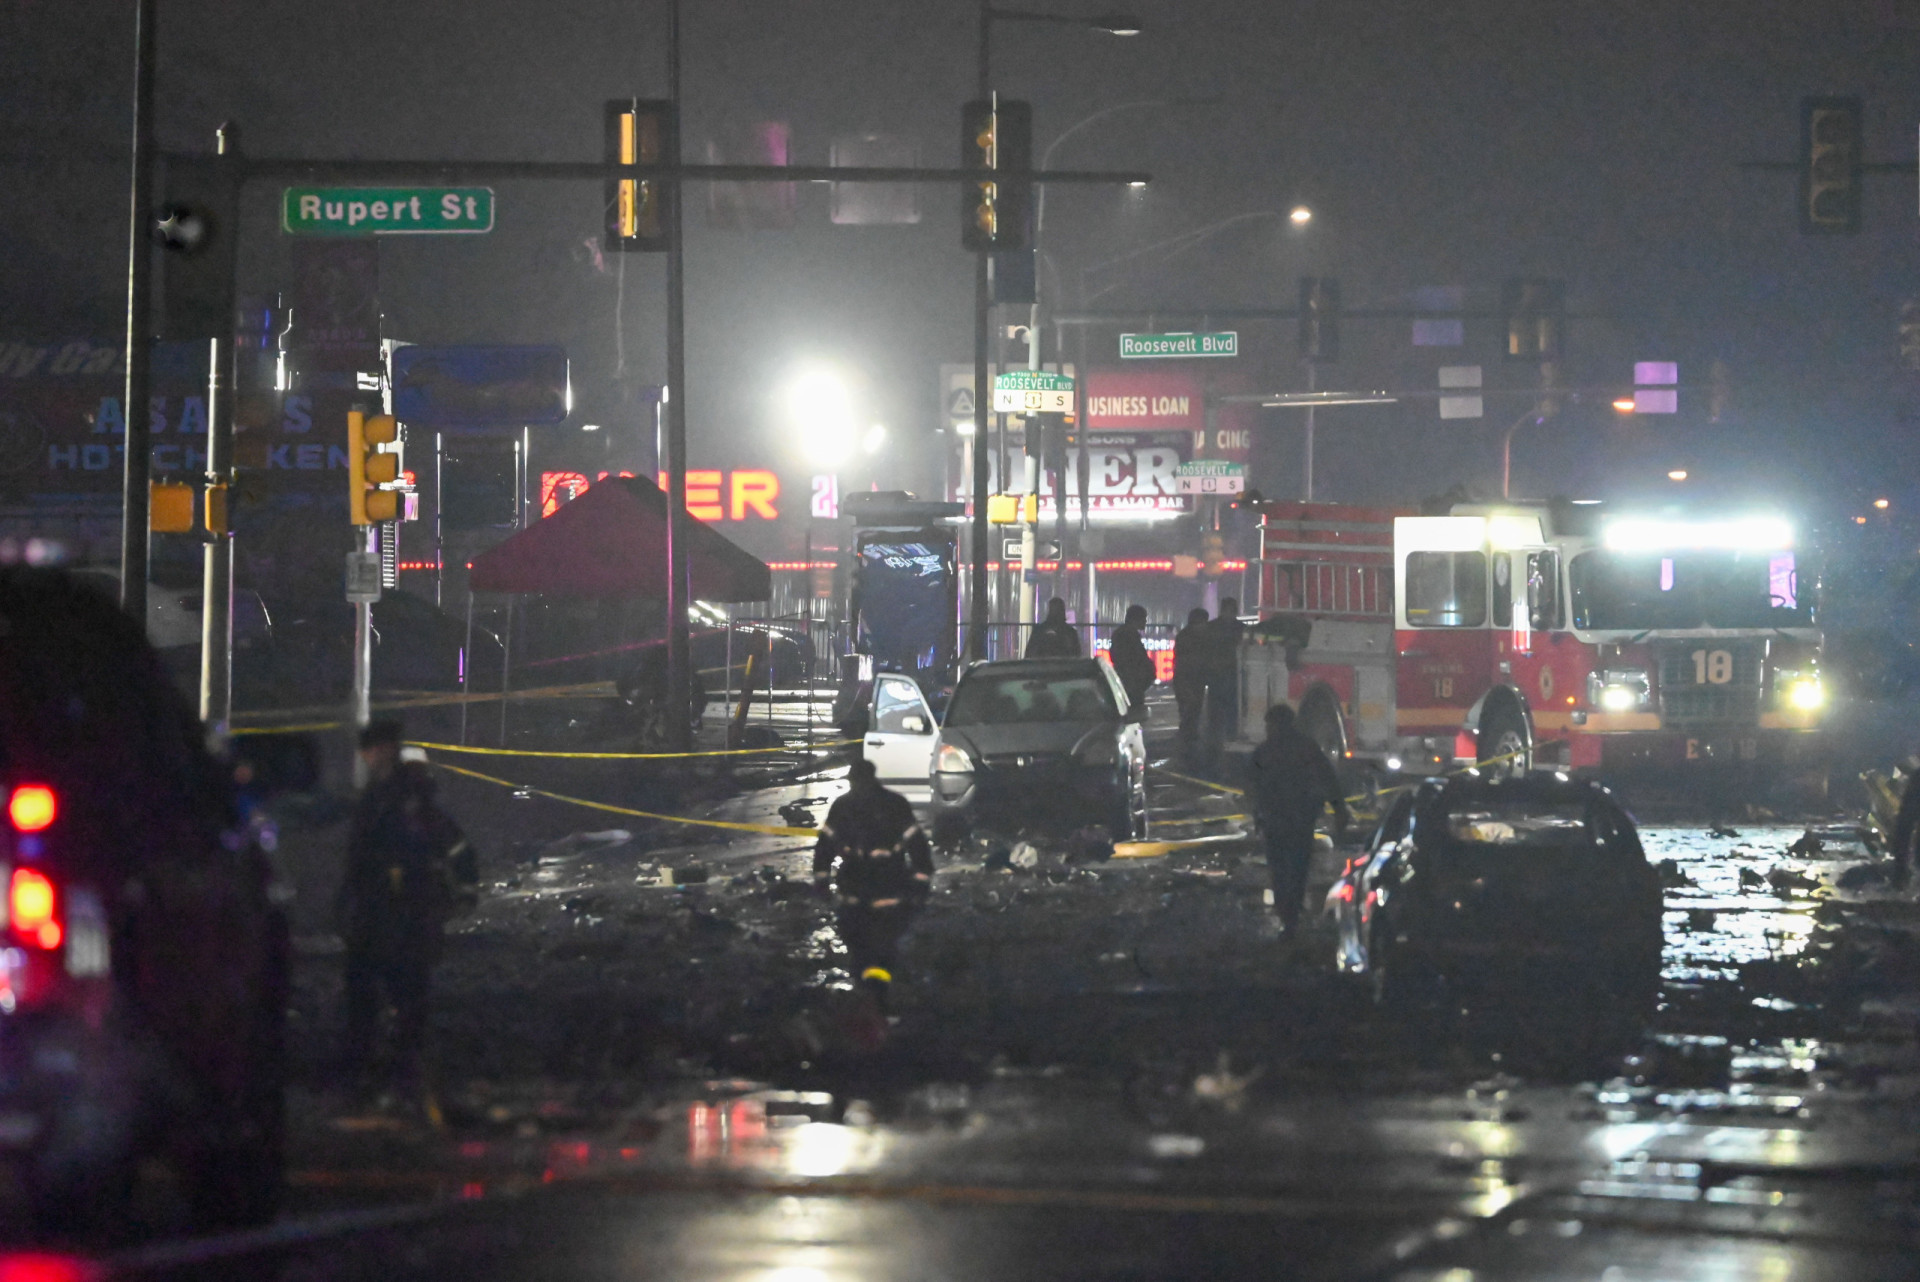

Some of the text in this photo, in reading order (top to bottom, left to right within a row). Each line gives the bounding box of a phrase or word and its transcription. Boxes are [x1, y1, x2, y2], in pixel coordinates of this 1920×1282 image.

[300, 193, 478, 226] Rupert St
[1123, 336, 1234, 353] Roosevelt Blvd
[996, 377, 1073, 390] ROOSEVELT BLVD
[1003, 394, 1064, 406] N 1 S
[1088, 396, 1190, 416] USINESS LOAN
[153, 443, 350, 470] CHKEN
[1176, 465, 1226, 476] ROOSEVELT
[1182, 480, 1191, 489] N
[1229, 480, 1236, 489] S
[541, 469, 781, 521] DER
[1113, 496, 1155, 509] SALAD
[1158, 496, 1185, 509] BAR
[1692, 649, 1733, 685] 18
[1433, 677, 1454, 699] 18
